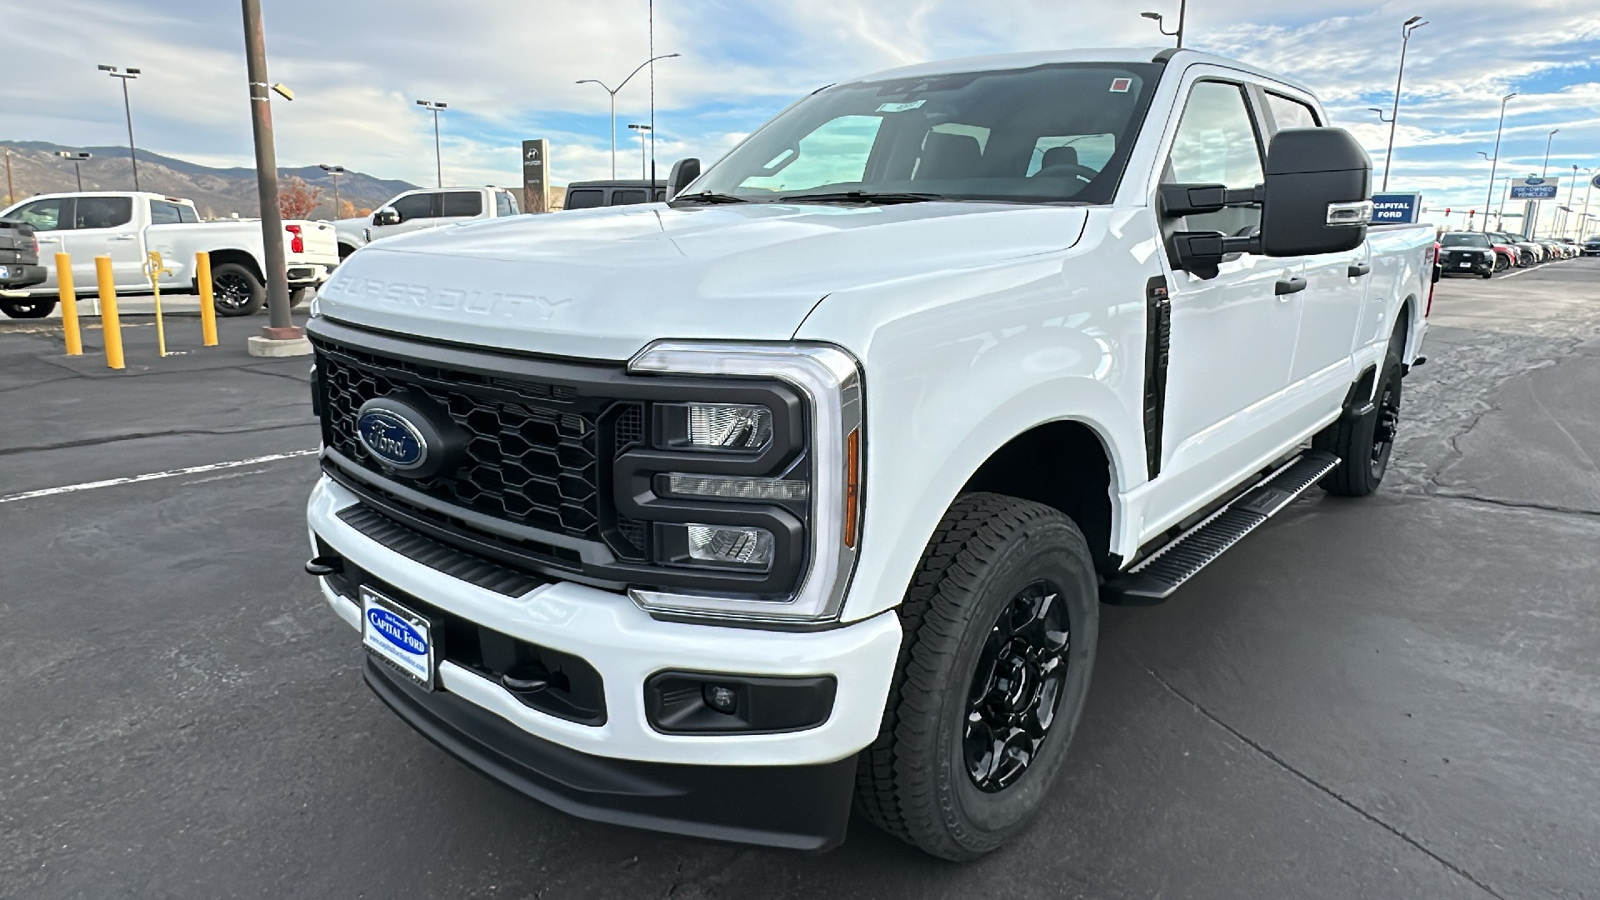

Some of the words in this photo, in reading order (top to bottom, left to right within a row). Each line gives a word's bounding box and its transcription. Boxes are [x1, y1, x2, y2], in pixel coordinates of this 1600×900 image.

[1373, 202, 1410, 210] CAPITAL
[432, 287, 574, 321] DUTY
[369, 419, 406, 458] Ford
[403, 629, 425, 653] FORD
